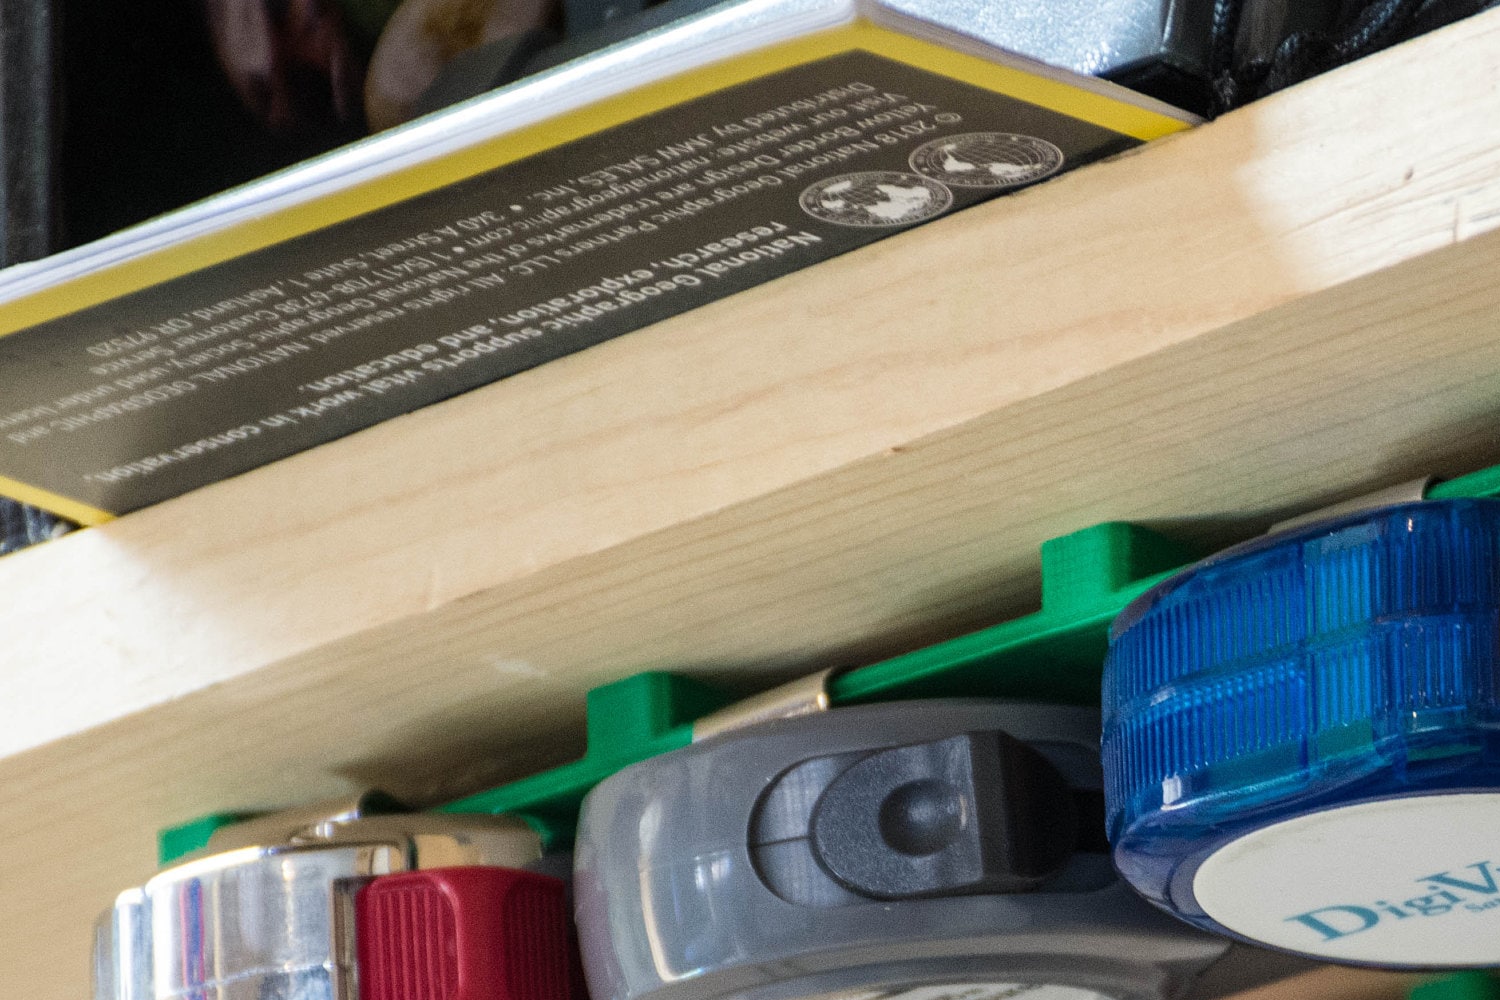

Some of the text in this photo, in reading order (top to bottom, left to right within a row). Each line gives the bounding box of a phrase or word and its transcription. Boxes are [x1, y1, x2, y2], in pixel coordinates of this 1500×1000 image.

[742, 81, 876, 129] Distributed
[849, 92, 907, 112] Visit
[856, 102, 936, 130] Yellow
[711, 123, 750, 138] by
[808, 108, 849, 126] our
[778, 125, 862, 158] Border
[873, 119, 937, 145] 2018
[656, 134, 714, 161] JMW
[776, 139, 880, 179] National
[694, 154, 781, 186] Design
[465, 155, 714, 248] nationalgeographic.com
[651, 174, 783, 223] Geographic
[655, 182, 696, 200] are
[456, 211, 506, 231] 340
[525, 197, 661, 247] trademarks
[502, 243, 528, 258] of
[553, 220, 659, 257] Partners
[650, 221, 788, 269] research,
[462, 252, 507, 269] the
[694, 230, 822, 278] National
[303, 258, 369, 281] Suite
[467, 272, 506, 289] All
[369, 266, 470, 302] National
[402, 284, 471, 310] rights
[488, 269, 655, 325] exploration,
[541, 274, 702, 331] Geographic
[150, 318, 193, 335] OR
[172, 309, 281, 349] Customer
[248, 297, 377, 342] Geographic
[86, 331, 159, 357] 97520
[420, 327, 543, 372] supports
[437, 324, 493, 349] and
[190, 341, 311, 382] NATIONAL
[114, 366, 170, 390] used
[358, 369, 424, 394] vital
[50, 380, 198, 430] GEOGRAPHIC
[289, 390, 363, 418] work
[7, 425, 51, 445] and
[259, 414, 298, 428] in
